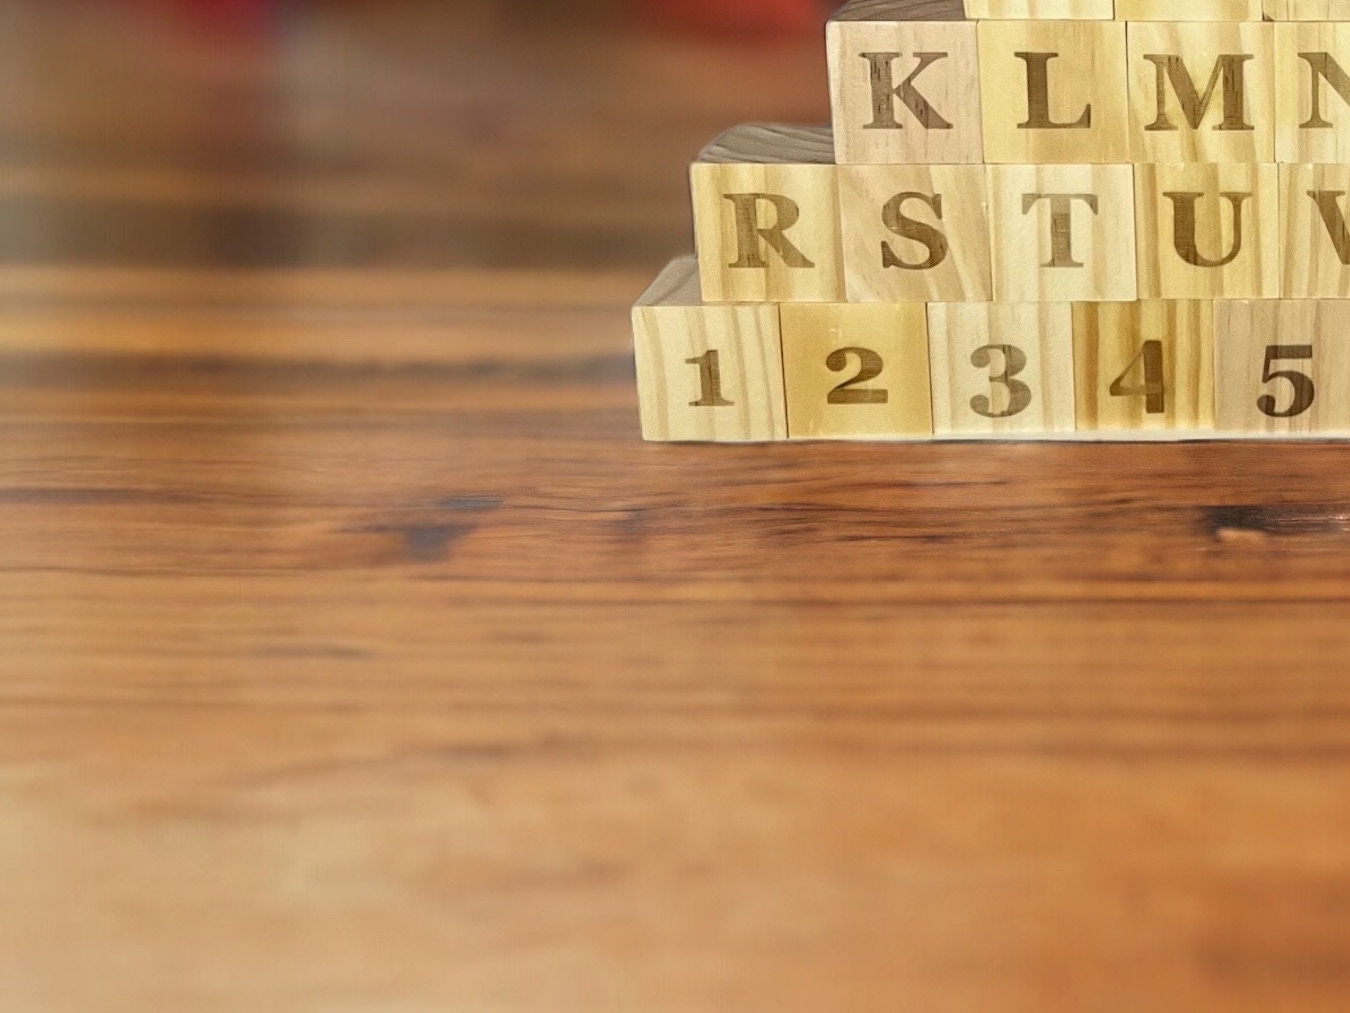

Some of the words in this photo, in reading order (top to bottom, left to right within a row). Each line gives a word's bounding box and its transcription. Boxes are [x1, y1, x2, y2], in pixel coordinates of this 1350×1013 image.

[860, 51, 953, 130] K
[1014, 51, 1092, 129] L
[1144, 52, 1255, 131] M
[723, 192, 815, 269] R
[880, 191, 949, 270] S
[1022, 192, 1099, 267] T
[1163, 190, 1253, 268] U
[685, 349, 735, 407] 1
[825, 347, 888, 405] 2
[969, 344, 1033, 417] 3
[1109, 339, 1165, 414] 4
[1256, 344, 1317, 418] 5
